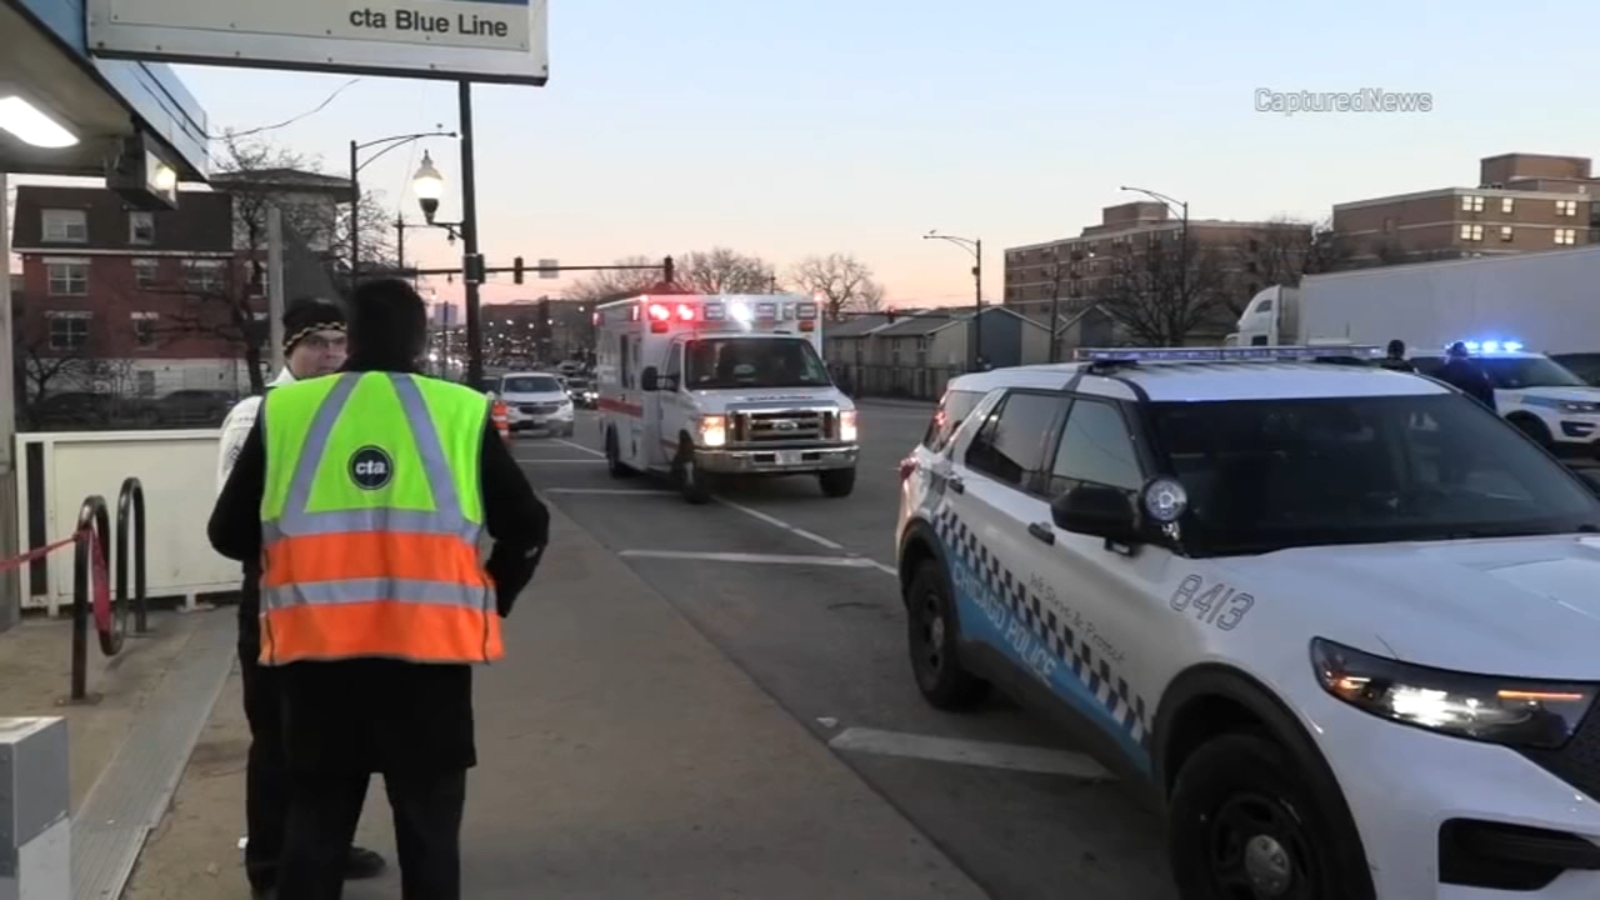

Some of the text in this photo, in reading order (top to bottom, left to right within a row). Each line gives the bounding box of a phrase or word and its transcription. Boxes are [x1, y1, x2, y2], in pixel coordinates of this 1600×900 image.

[349, 8, 508, 37] cta Blue Line
[355, 459, 387, 475] cta
[952, 561, 1057, 684] CHICAGO POLICE
[1169, 574, 1255, 631] 8413
